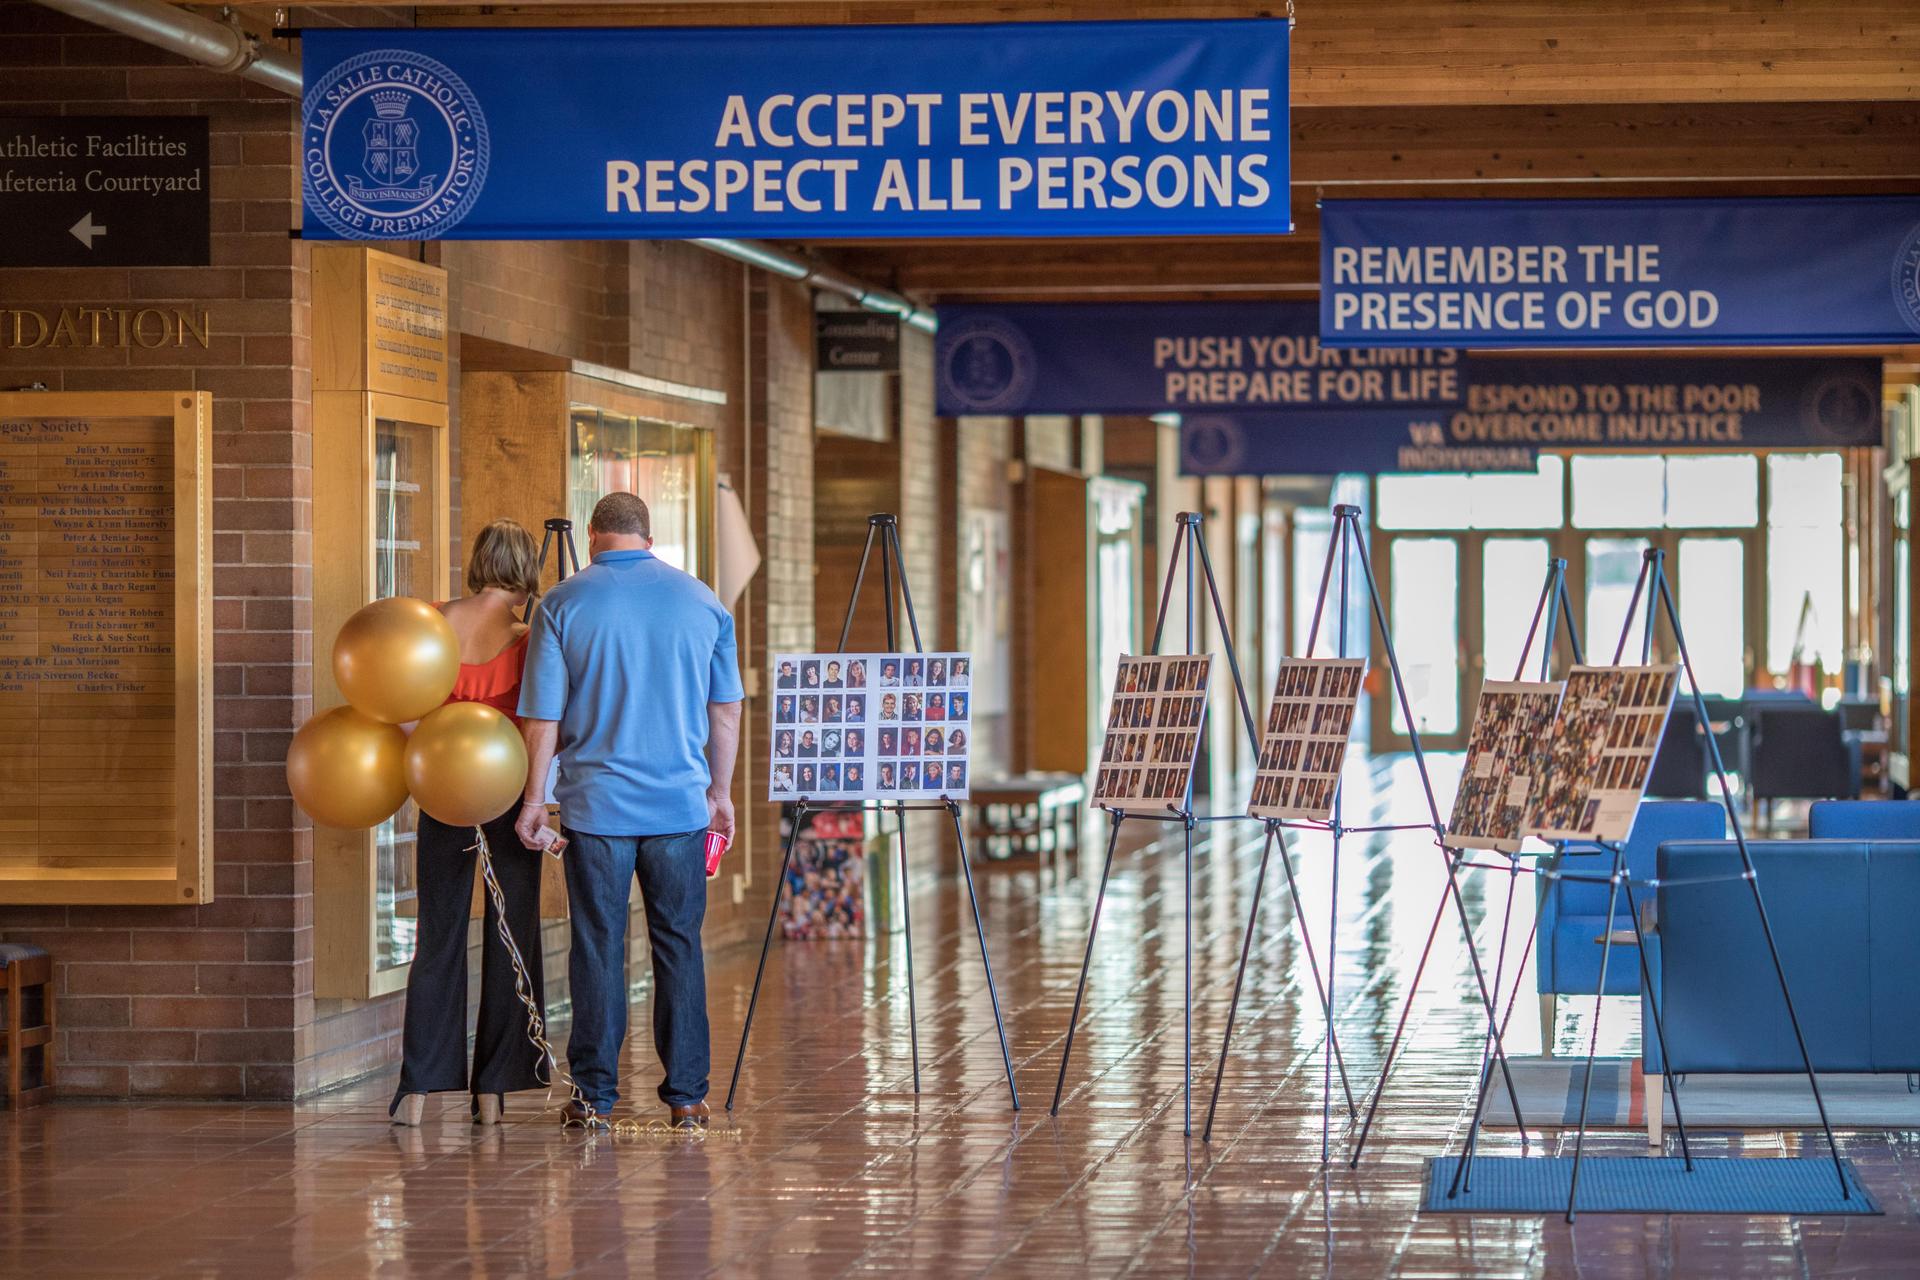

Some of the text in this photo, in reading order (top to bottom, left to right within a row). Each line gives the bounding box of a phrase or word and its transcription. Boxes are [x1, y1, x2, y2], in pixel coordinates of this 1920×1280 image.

[309, 64, 472, 133] LA SALLE CATHOLIC
[714, 88, 1271, 148] ACCEPT EVERYONE
[86, 134, 187, 158] Facilities
[0, 168, 201, 197] feteria Courtyard
[306, 144, 476, 234] COLLEGE PREPARATORY
[606, 153, 1271, 213] RESPECT ALL PERSONS
[1332, 244, 1661, 285] REMEMBER THE
[1334, 289, 1719, 331] PRESENCE OF GOD
[0, 306, 209, 350] DATION
[1153, 337, 1243, 368] PUSH
[1247, 335, 1342, 367] YOUR
[1165, 369, 1458, 402] PREPARE FOR LIFE
[1582, 384, 1621, 412] TO
[1625, 384, 1678, 412] THE
[1683, 384, 1761, 412] POOR
[41, 420, 91, 436] Society
[1451, 412, 1744, 441] OVERCOME INJUSTICE
[65, 457, 91, 466] Brian
[81, 483, 88, 492] &
[122, 483, 164, 492] Cameron
[59, 508, 66, 516] &
[86, 520, 94, 529] &
[63, 533, 87, 542] Peter
[90, 533, 97, 542] &
[134, 533, 159, 542] Jones
[91, 545, 99, 554] &
[102, 545, 122, 554] Kim
[90, 583, 98, 592] &
[128, 583, 156, 593] Regan
[58, 609, 85, 618] David
[87, 609, 96, 618] &
[51, 645, 100, 655] Monsignor
[102, 645, 134, 654] Martin
[72, 633, 94, 642] Rick
[96, 633, 104, 642] &
[127, 633, 151, 642] Scott
